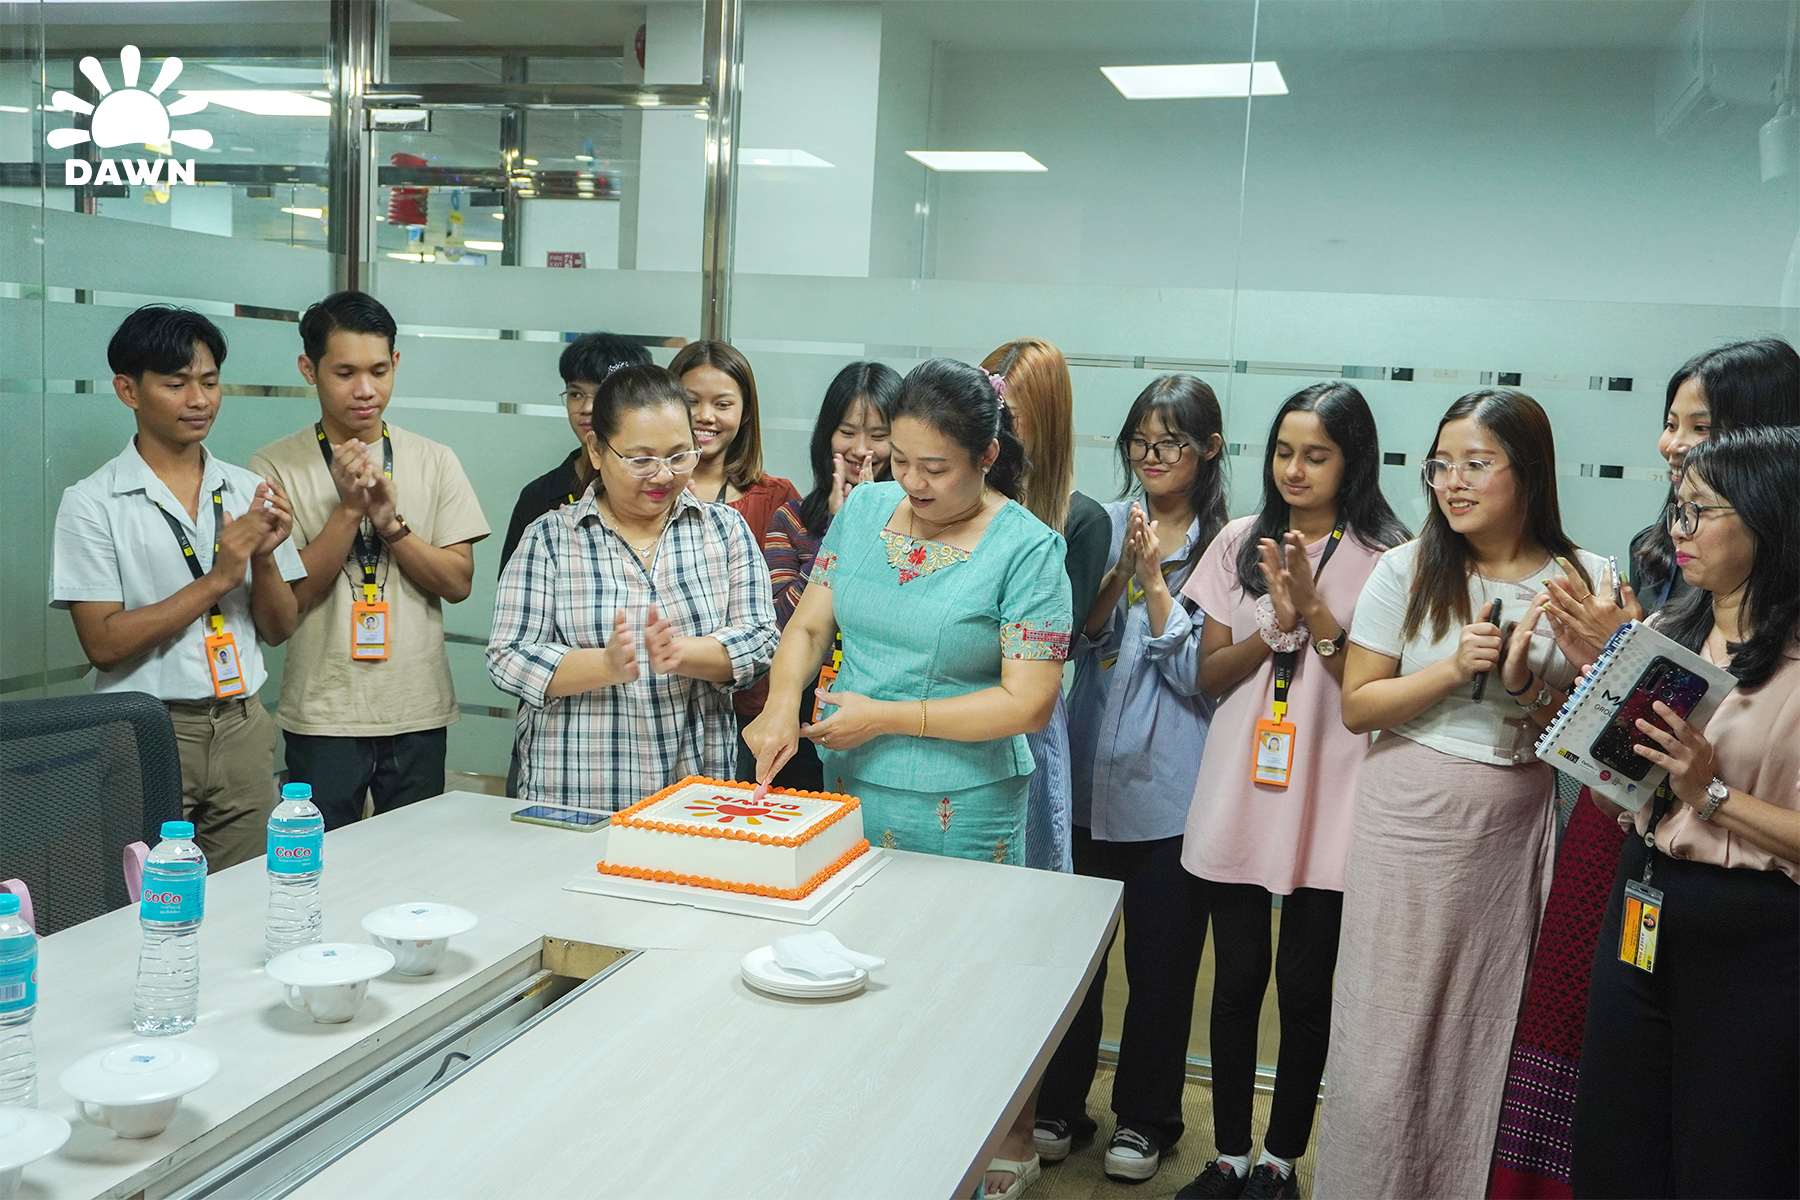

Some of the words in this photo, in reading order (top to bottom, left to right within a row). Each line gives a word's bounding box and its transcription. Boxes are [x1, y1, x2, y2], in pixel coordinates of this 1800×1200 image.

[1594, 703, 1614, 718] GROU
[1557, 747, 1580, 765] mibs
[275, 846, 312, 858] CoCo
[144, 889, 182, 904] CoCo
